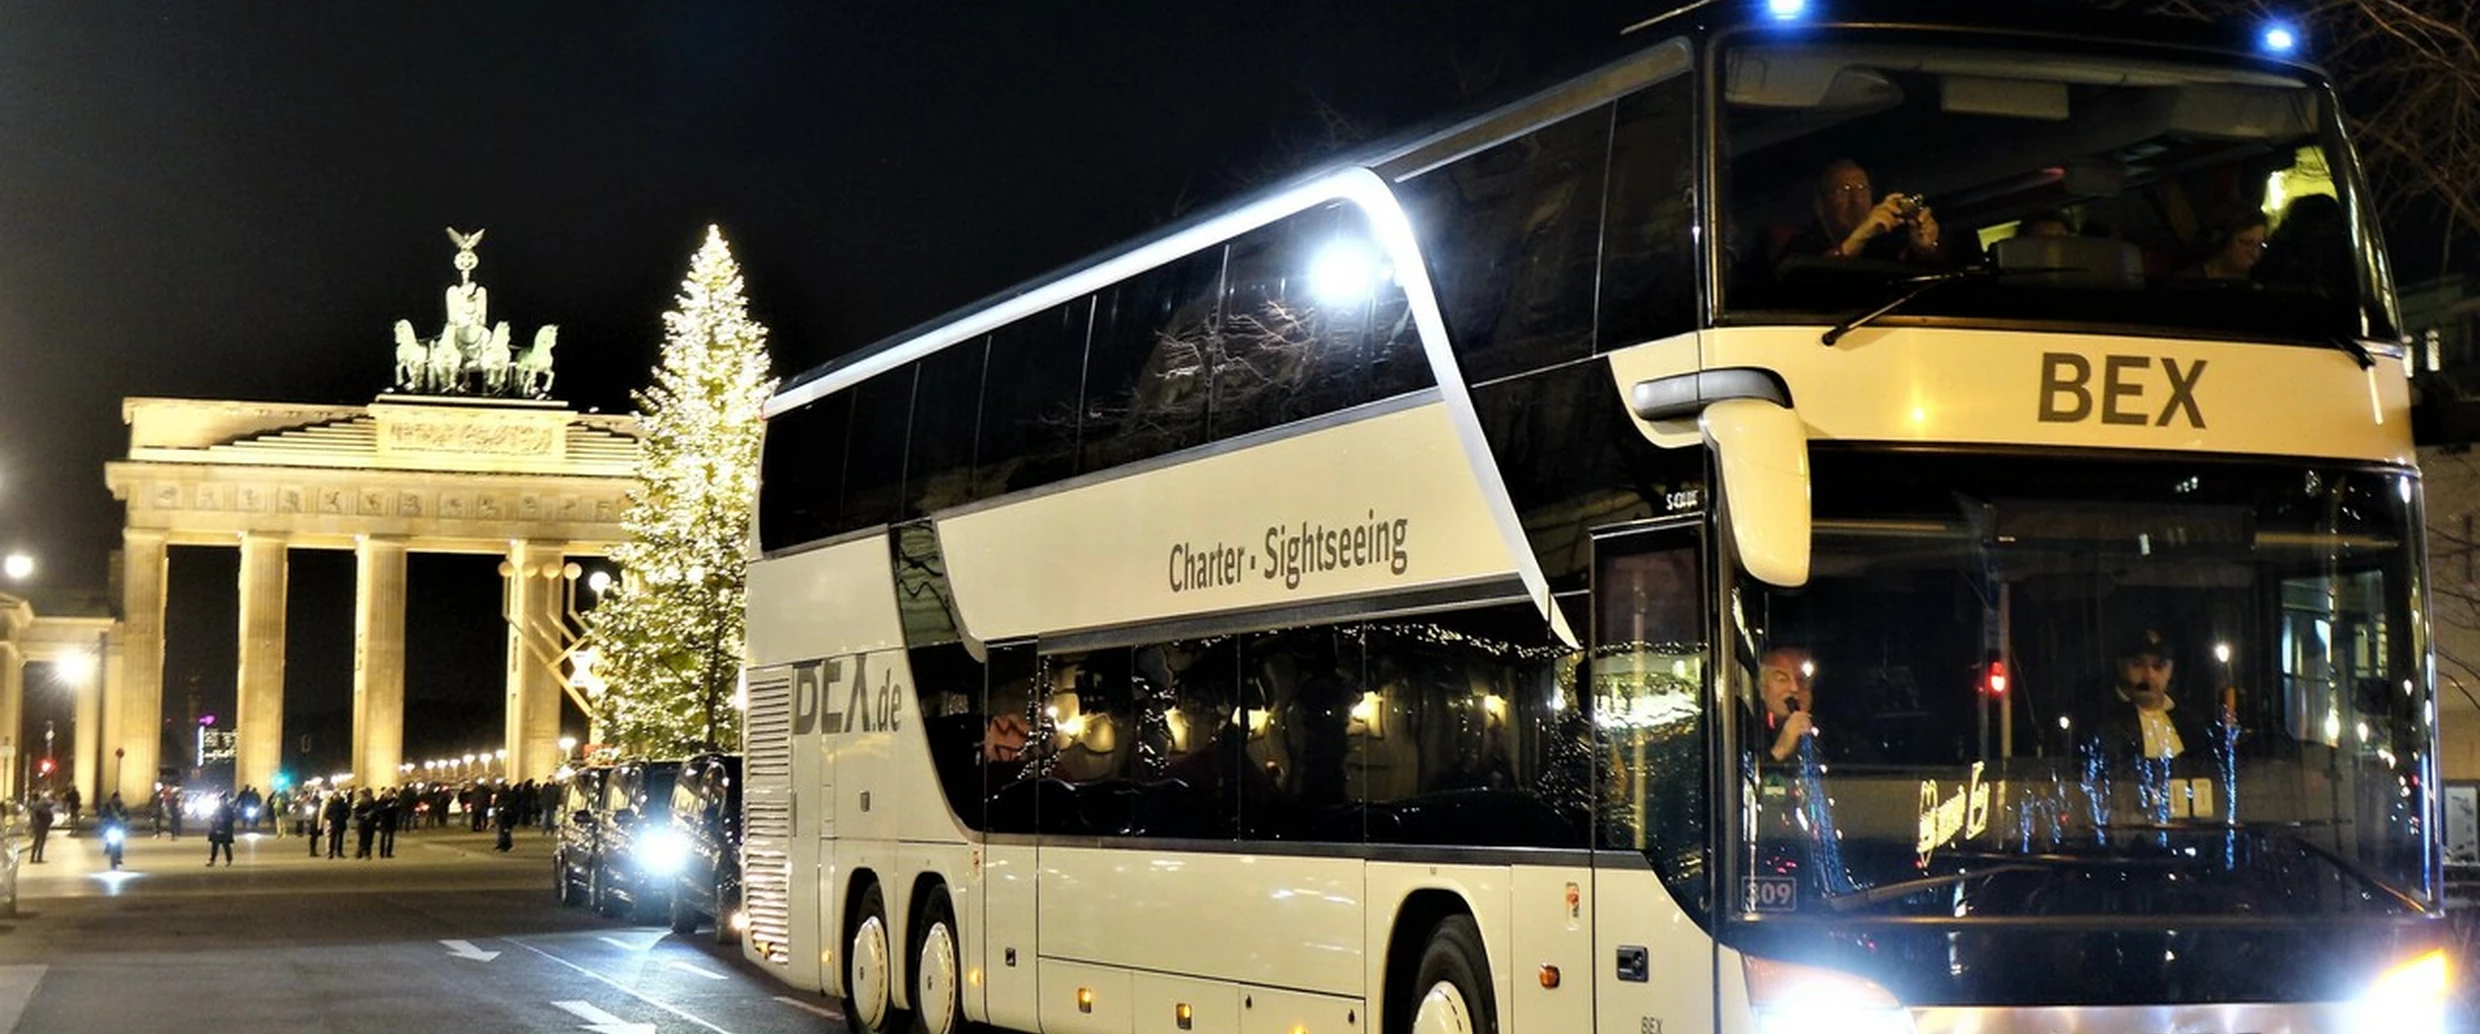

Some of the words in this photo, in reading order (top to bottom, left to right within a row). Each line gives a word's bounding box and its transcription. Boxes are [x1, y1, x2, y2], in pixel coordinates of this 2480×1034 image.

[2038, 352, 2208, 430] BEX
[1169, 542, 1245, 593] Charter
[1264, 508, 1408, 590] Sightseeing
